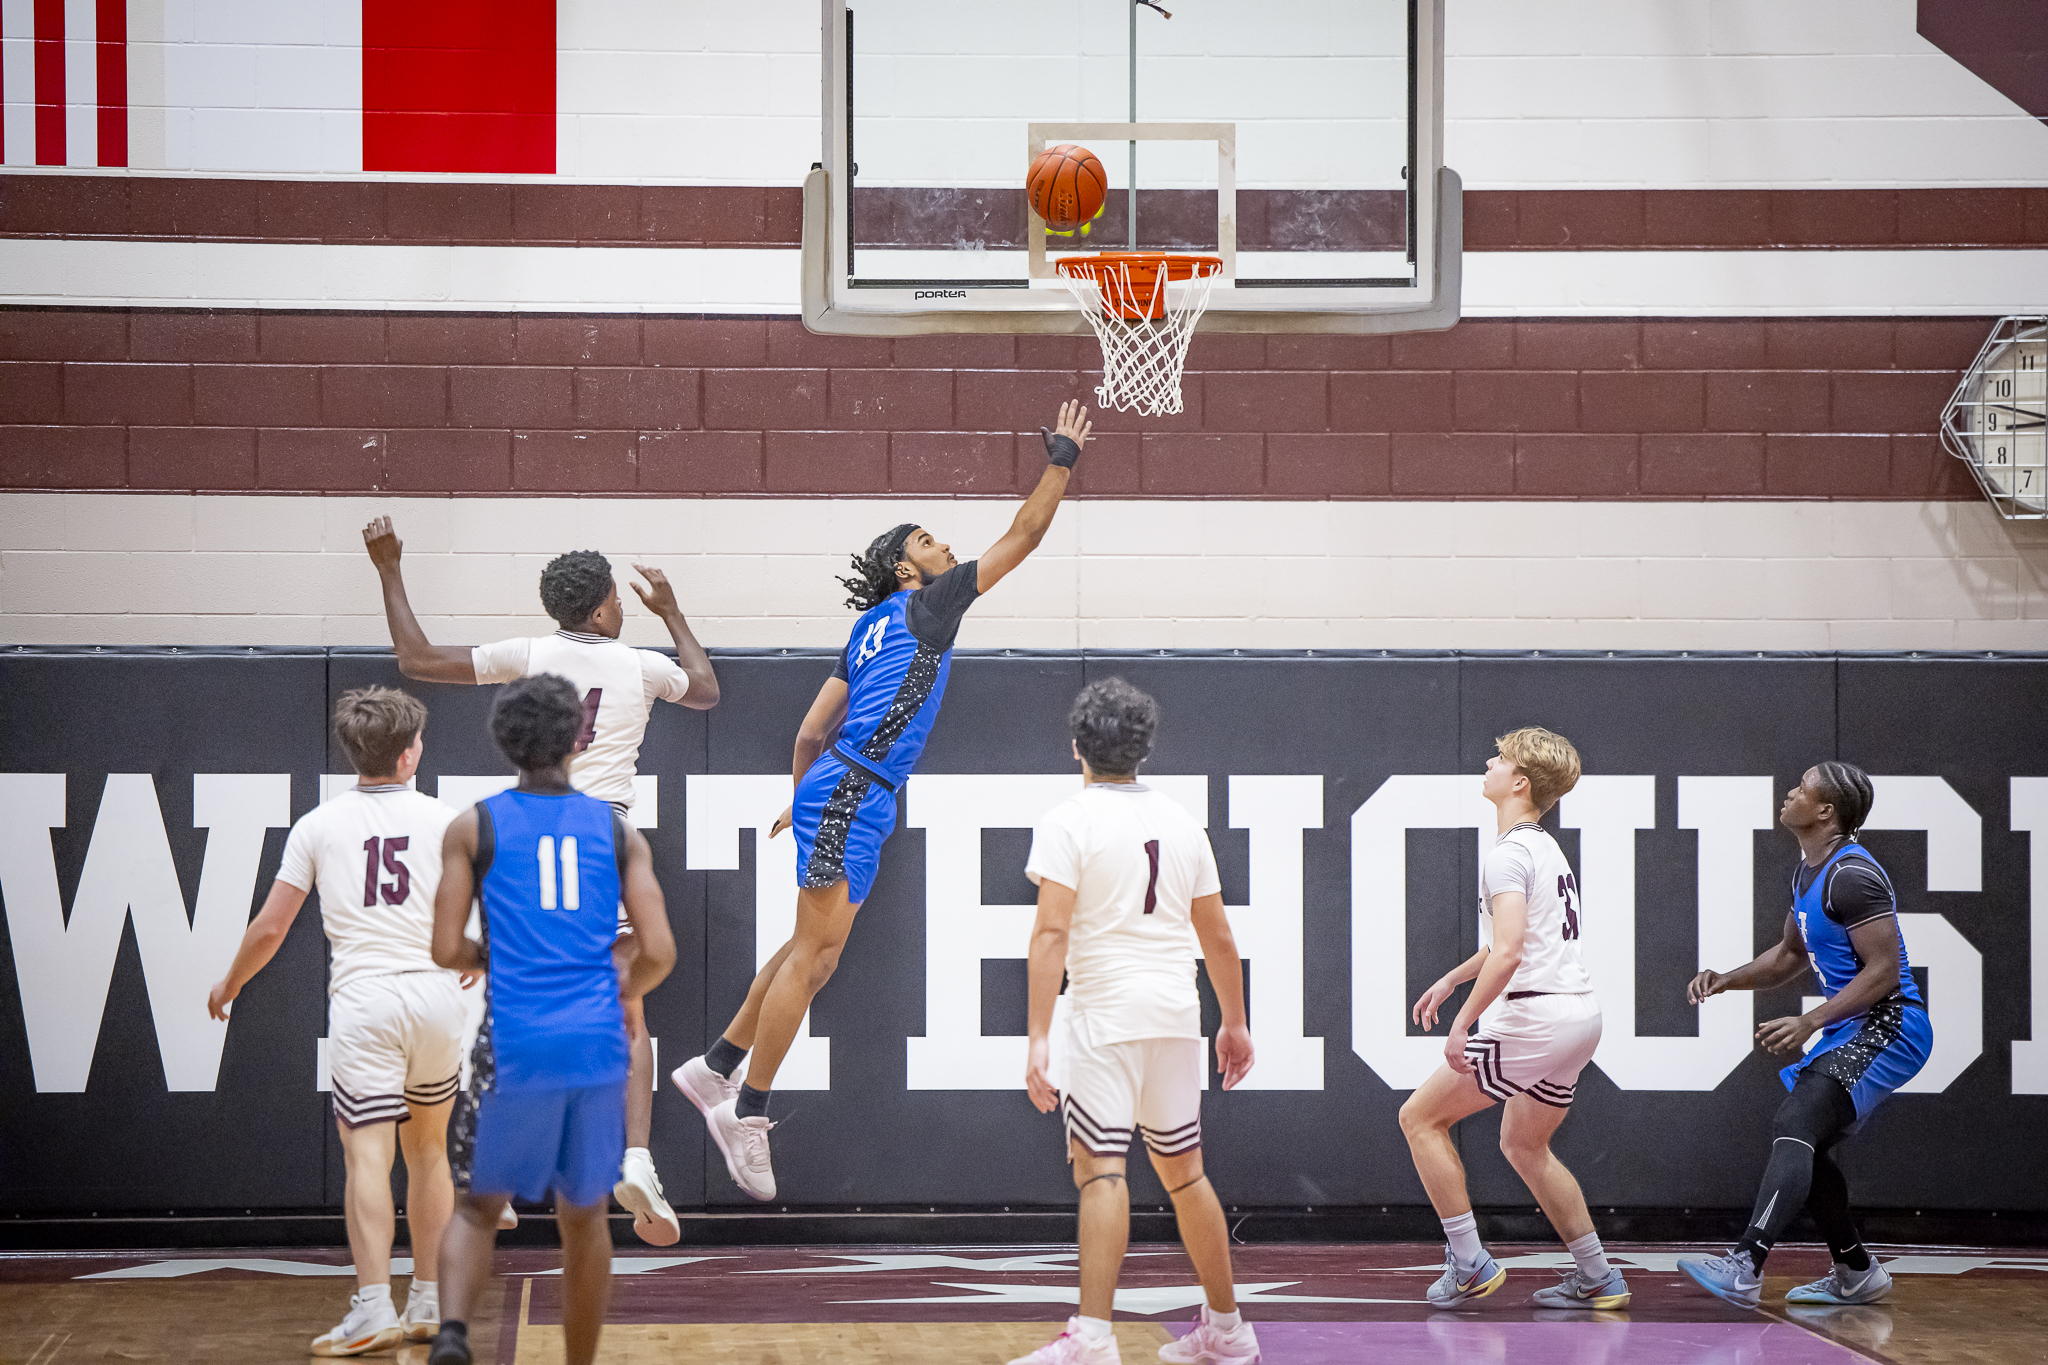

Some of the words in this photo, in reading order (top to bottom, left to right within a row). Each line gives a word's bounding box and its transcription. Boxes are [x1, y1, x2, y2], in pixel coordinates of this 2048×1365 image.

[1114, 298, 1154, 308] SALDIN
[2022, 355, 2035, 371] 11
[1995, 379, 2011, 398] 10
[1988, 413, 1997, 431] 9
[1997, 446, 2007, 465] 8
[2022, 470, 2033, 489] 7
[363, 835, 410, 907] 15
[537, 835, 580, 911] 11
[1143, 839, 1160, 915] 1
